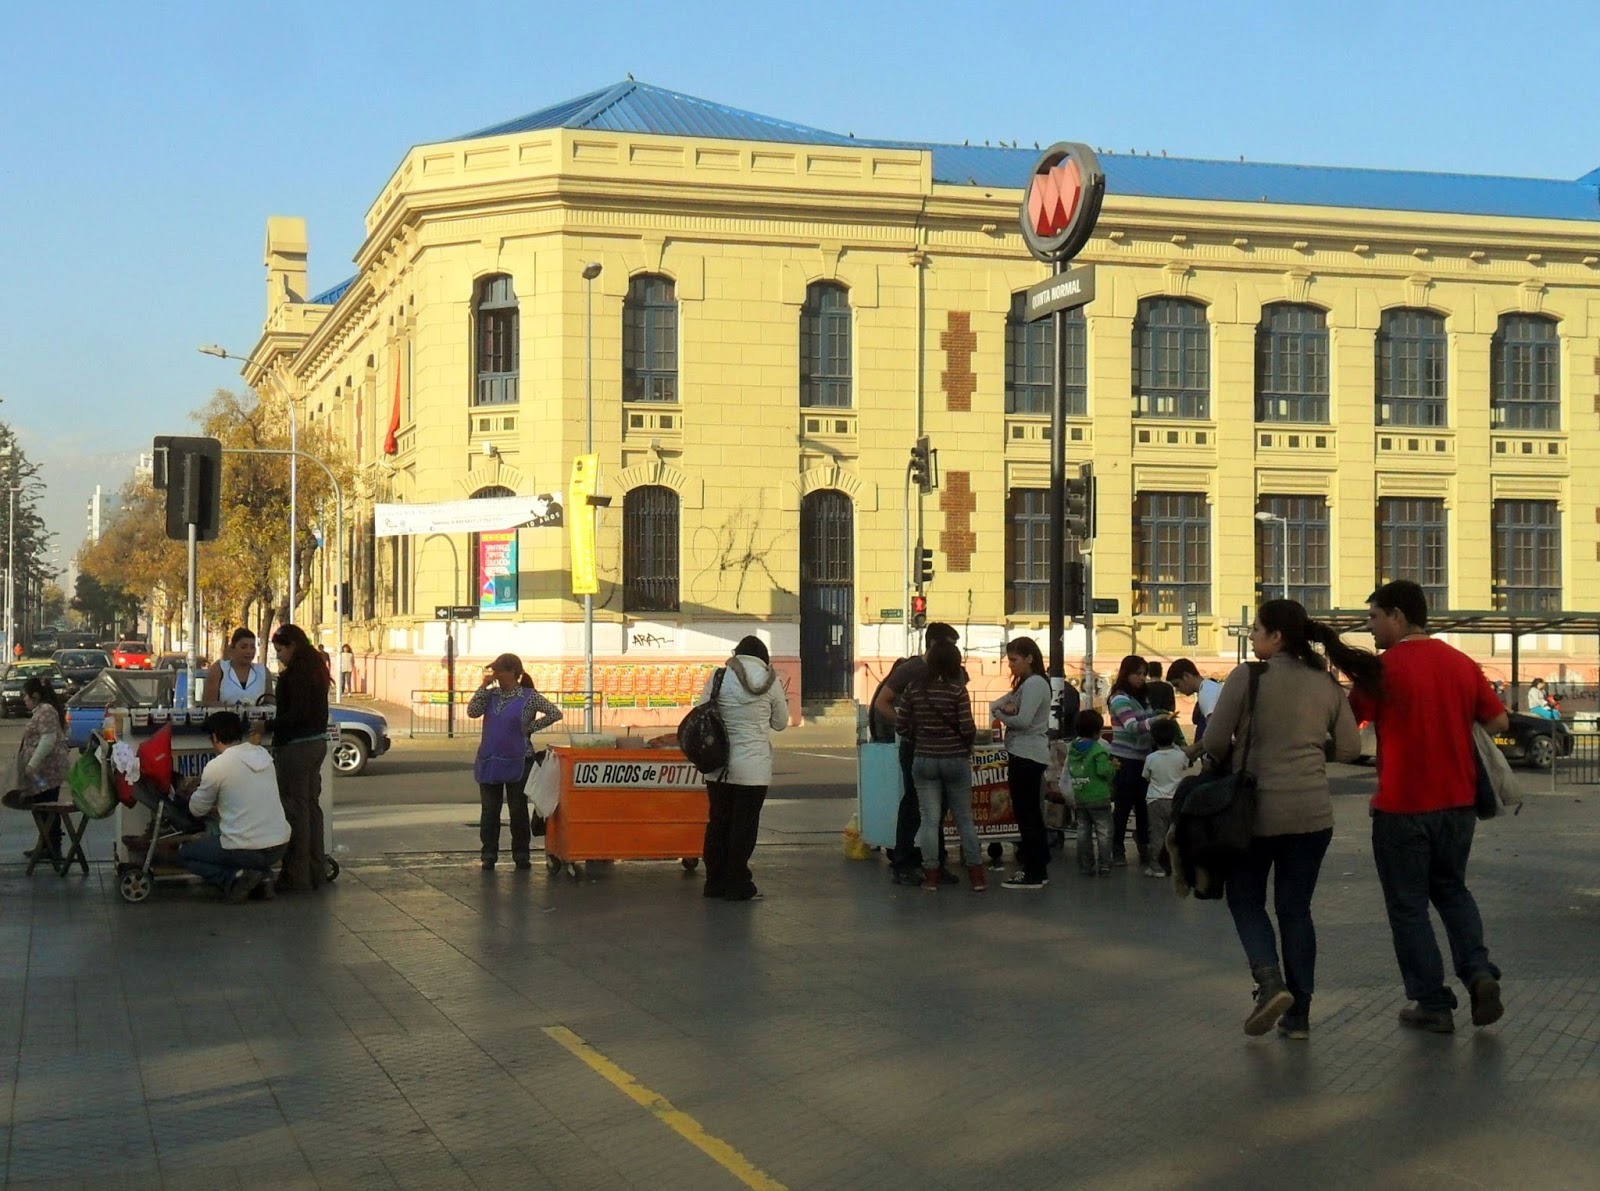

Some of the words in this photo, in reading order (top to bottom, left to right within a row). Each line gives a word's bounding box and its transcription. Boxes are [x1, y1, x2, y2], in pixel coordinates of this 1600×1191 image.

[1032, 288, 1050, 310] QUINTA
[1051, 279, 1082, 301] NORMAL
[575, 764, 598, 784] LOS
[602, 764, 642, 783] RICOS
[642, 765, 657, 781] de
[658, 765, 706, 784] POTIT
[971, 766, 1009, 787] AIPILL
[985, 823, 1019, 834] CALIDAD
